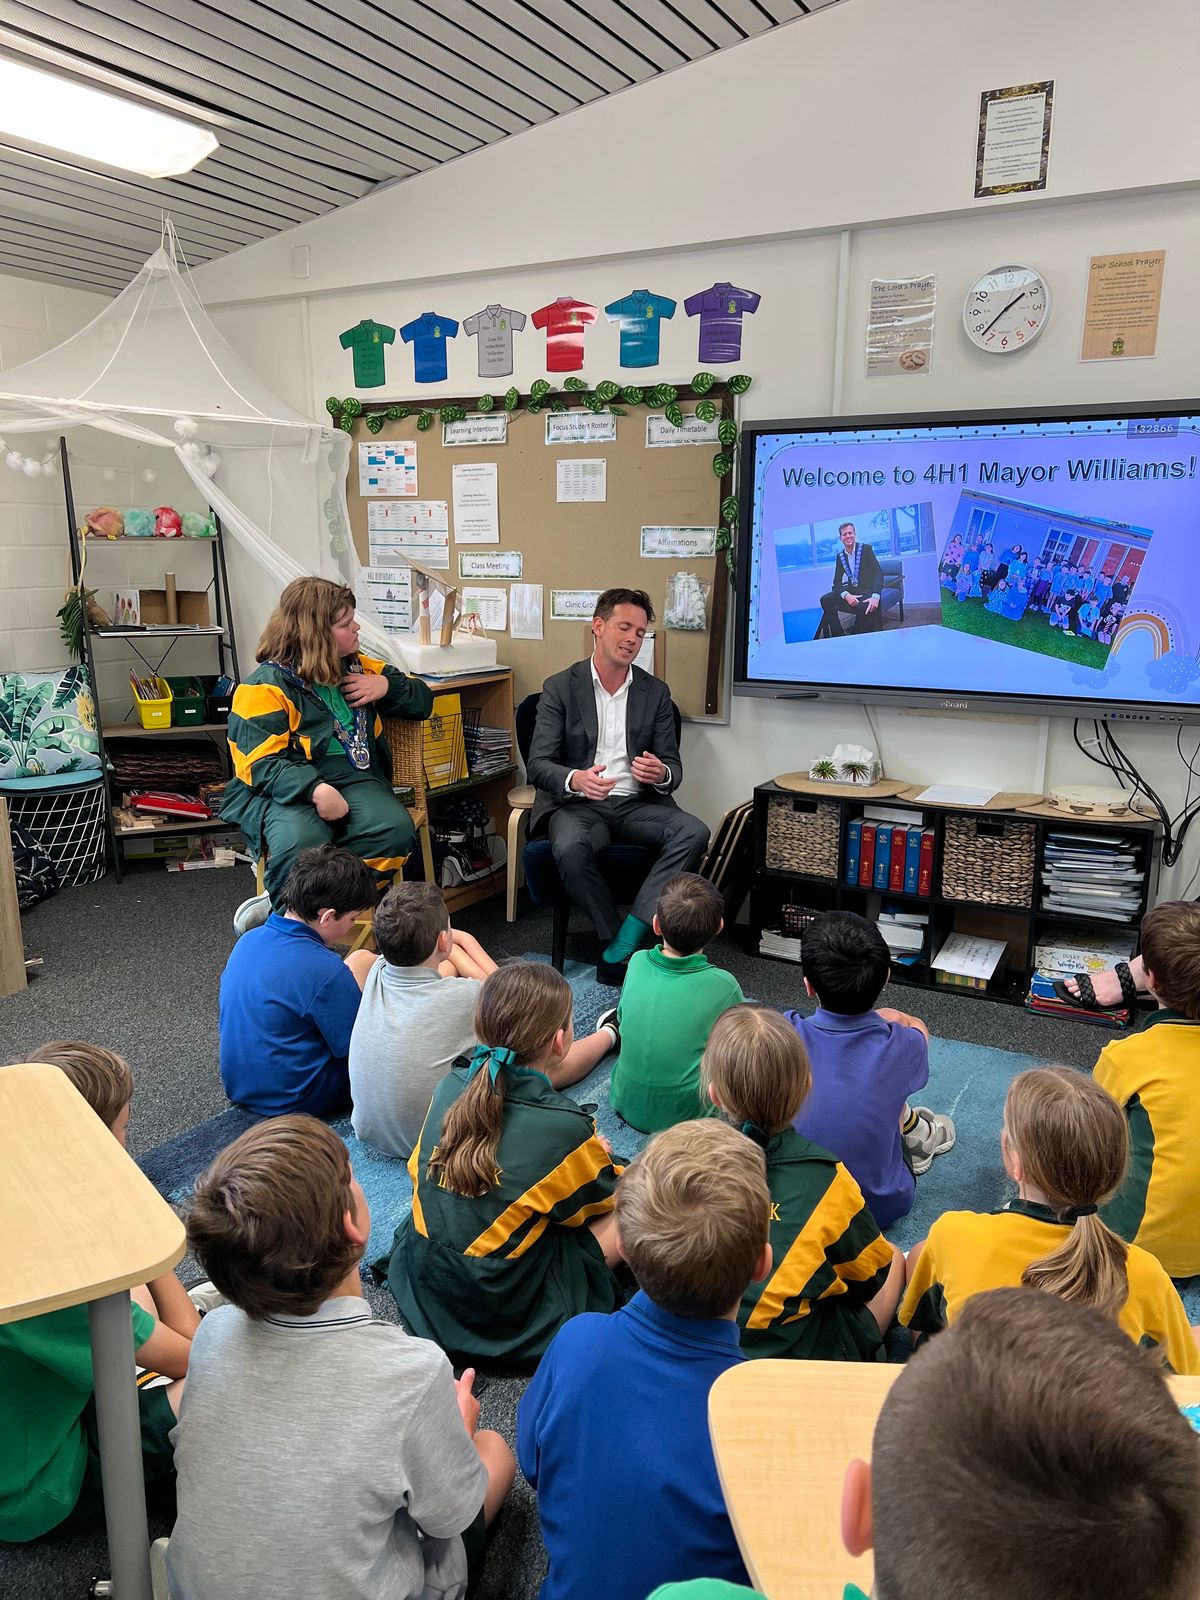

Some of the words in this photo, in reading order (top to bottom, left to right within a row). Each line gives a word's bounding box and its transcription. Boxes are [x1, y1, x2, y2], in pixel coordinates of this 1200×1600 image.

[1108, 260, 1133, 268] School
[1135, 257, 1162, 268] Prayer
[1004, 273, 1015, 283] 12
[887, 282, 908, 291] Lord's
[909, 281, 932, 291] Prayer
[976, 290, 988, 302] 10
[1029, 287, 1040, 297] 2
[1032, 303, 1042, 311] 3
[975, 323, 985, 332] 8
[1027, 320, 1037, 328] 4
[986, 332, 996, 342] 7
[1016, 330, 1025, 340] 5
[1001, 336, 1008, 346] 6
[450, 427, 472, 435] Learning
[472, 425, 499, 433] Intentions
[553, 423, 569, 431] Focus
[591, 421, 609, 429] Roster
[660, 426, 675, 434] Daily
[1134, 424, 1174, 434] 132866
[782, 466, 886, 488] Welcome
[893, 464, 917, 485] to
[923, 461, 969, 485] 4H1
[978, 462, 1060, 488] Mayor
[1067, 455, 1198, 481] Williams!
[657, 538, 698, 546] Affirmations
[486, 562, 511, 571] Meeting
[564, 600, 581, 608] Clinic
